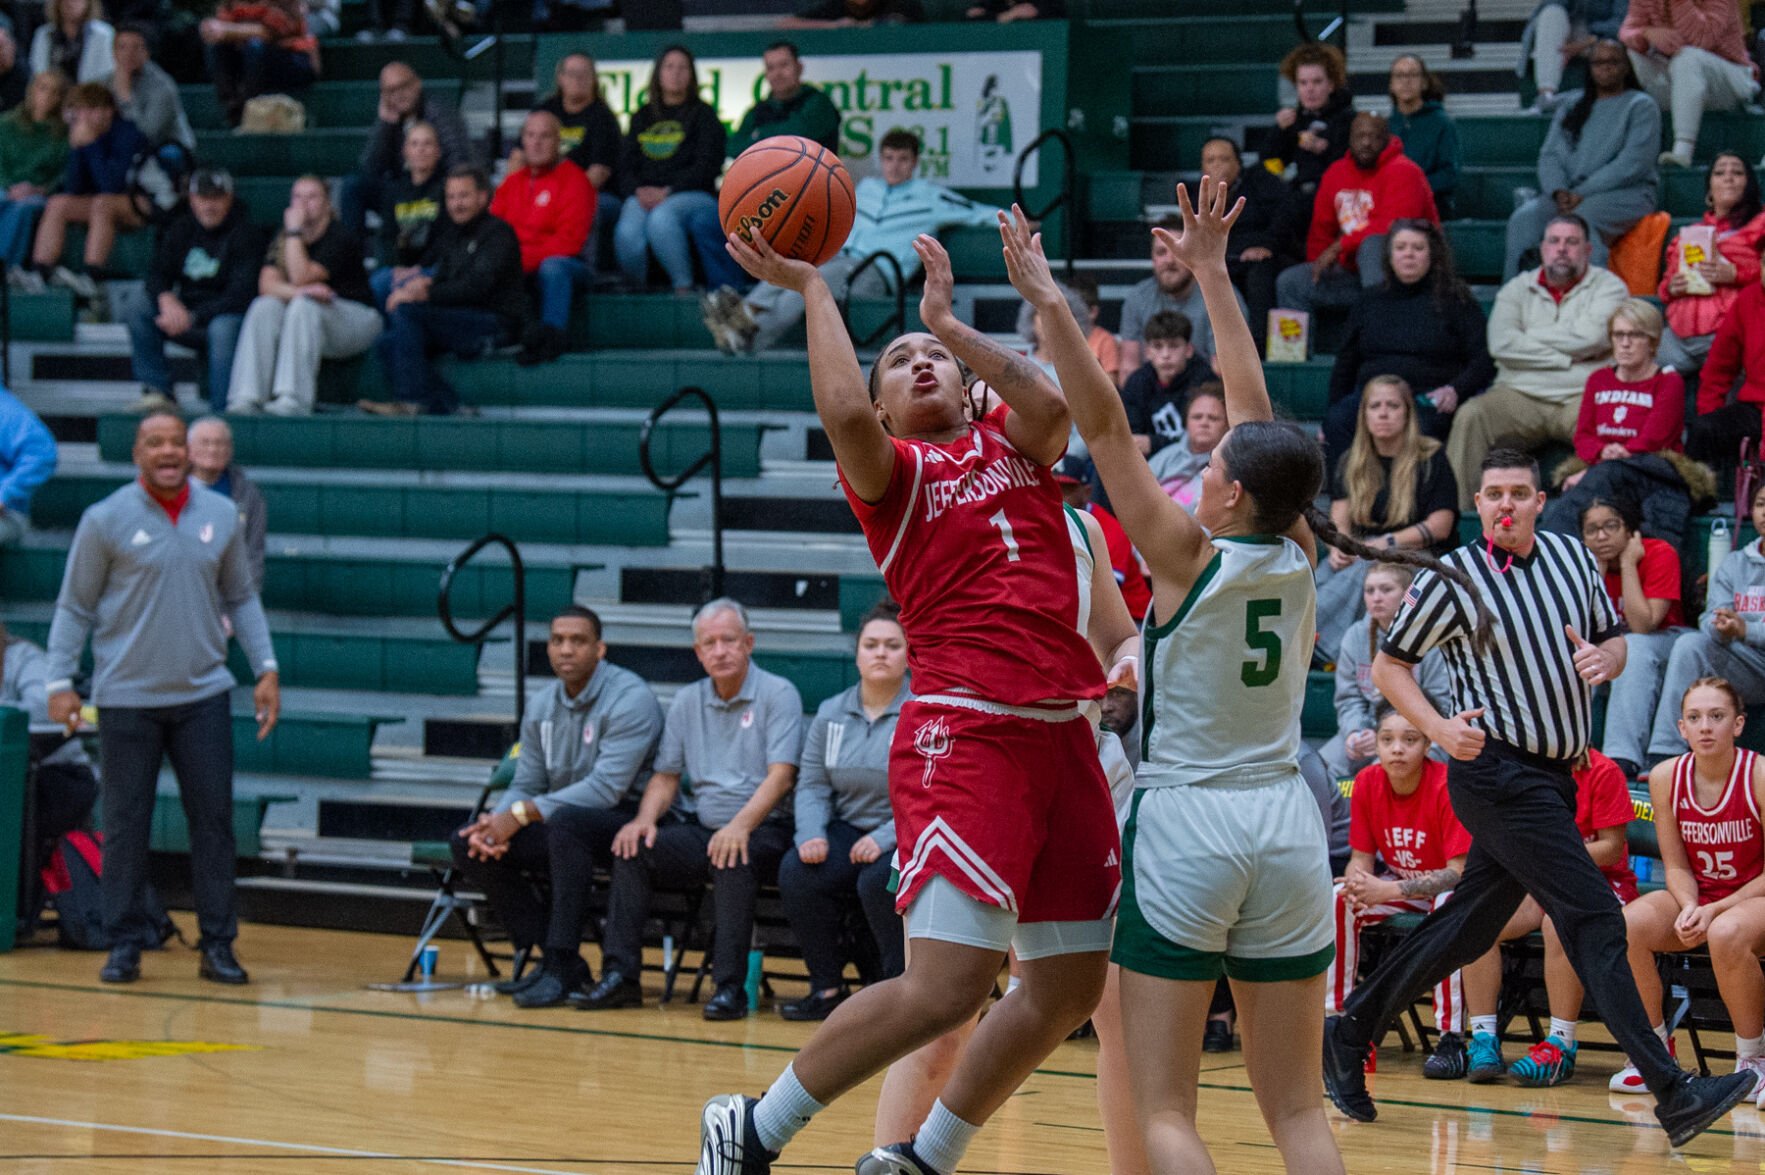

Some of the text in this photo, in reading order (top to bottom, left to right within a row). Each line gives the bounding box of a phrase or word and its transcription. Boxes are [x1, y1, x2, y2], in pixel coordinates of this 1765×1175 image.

[735, 188, 789, 243] ilson
[924, 456, 1040, 523] JEFFERSONVILE
[988, 507, 1020, 562] 1
[1241, 598, 1282, 687] 5
[1696, 850, 1738, 880] 25
